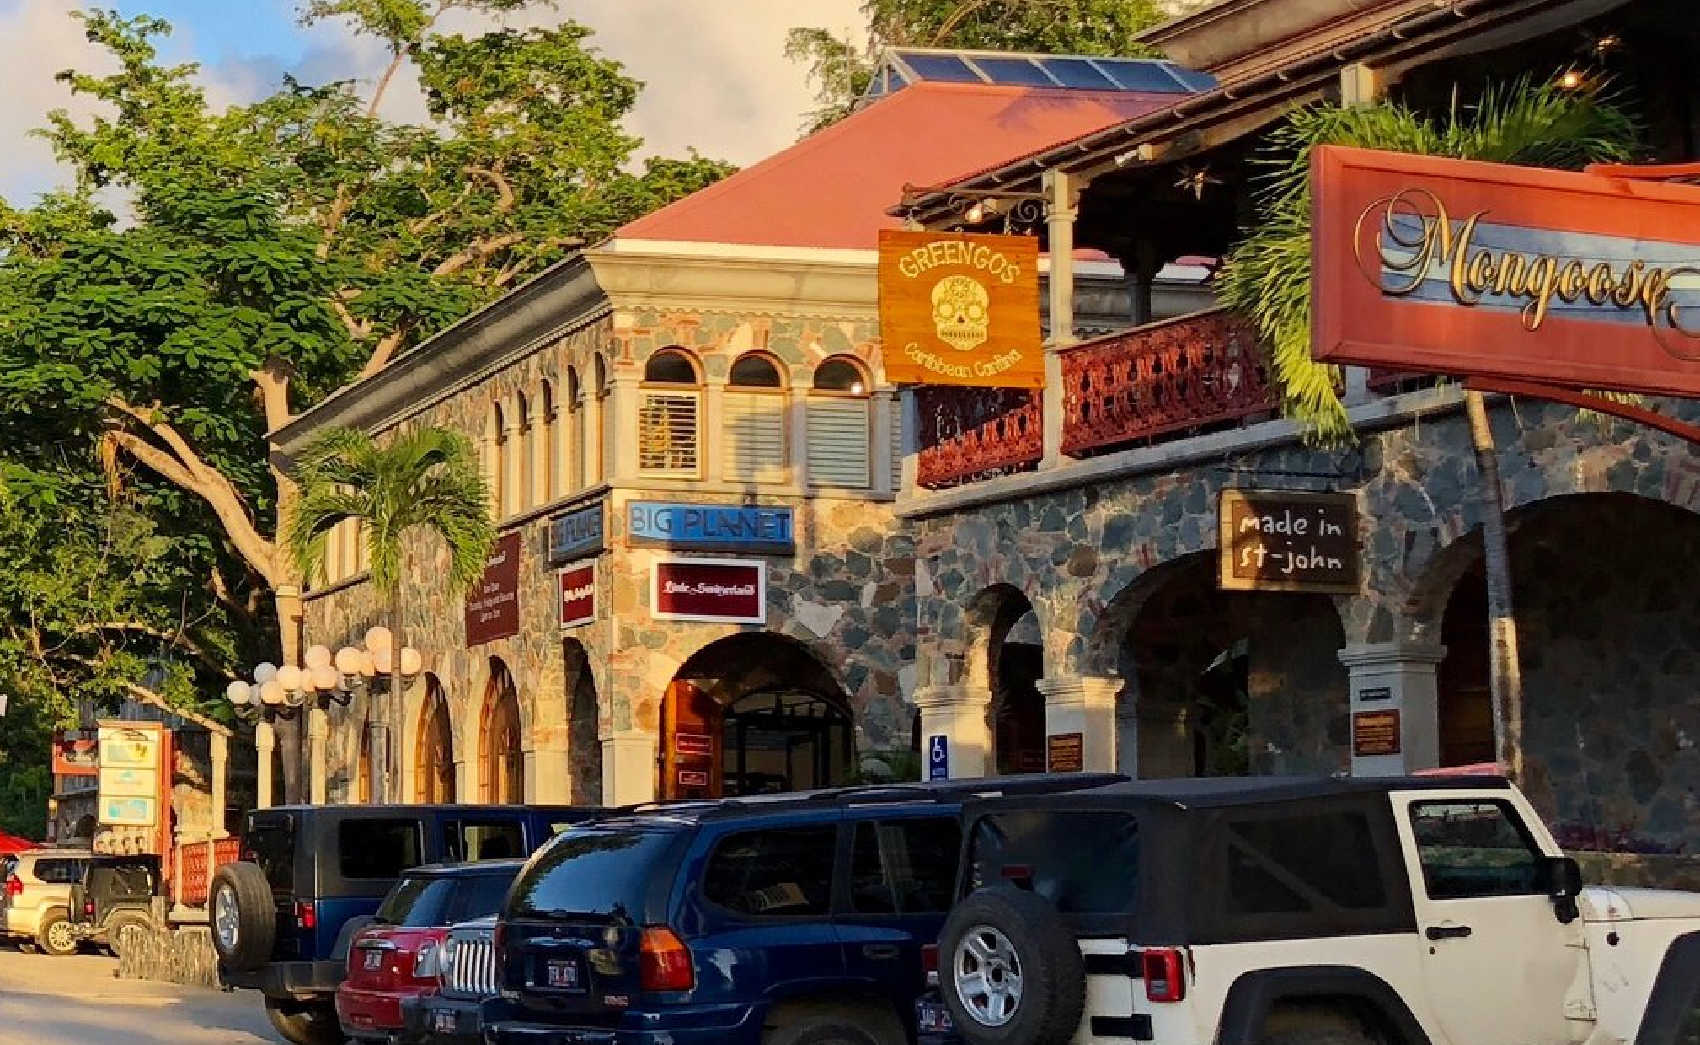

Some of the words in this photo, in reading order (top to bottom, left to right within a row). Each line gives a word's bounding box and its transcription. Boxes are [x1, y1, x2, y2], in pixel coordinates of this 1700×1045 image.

[1354, 187, 1670, 331] Mongoose
[905, 343, 972, 378] Caribbean
[631, 507, 673, 533] BIG
[684, 508, 790, 540] PLANET
[1239, 510, 1308, 535] made
[1318, 508, 1342, 537] in
